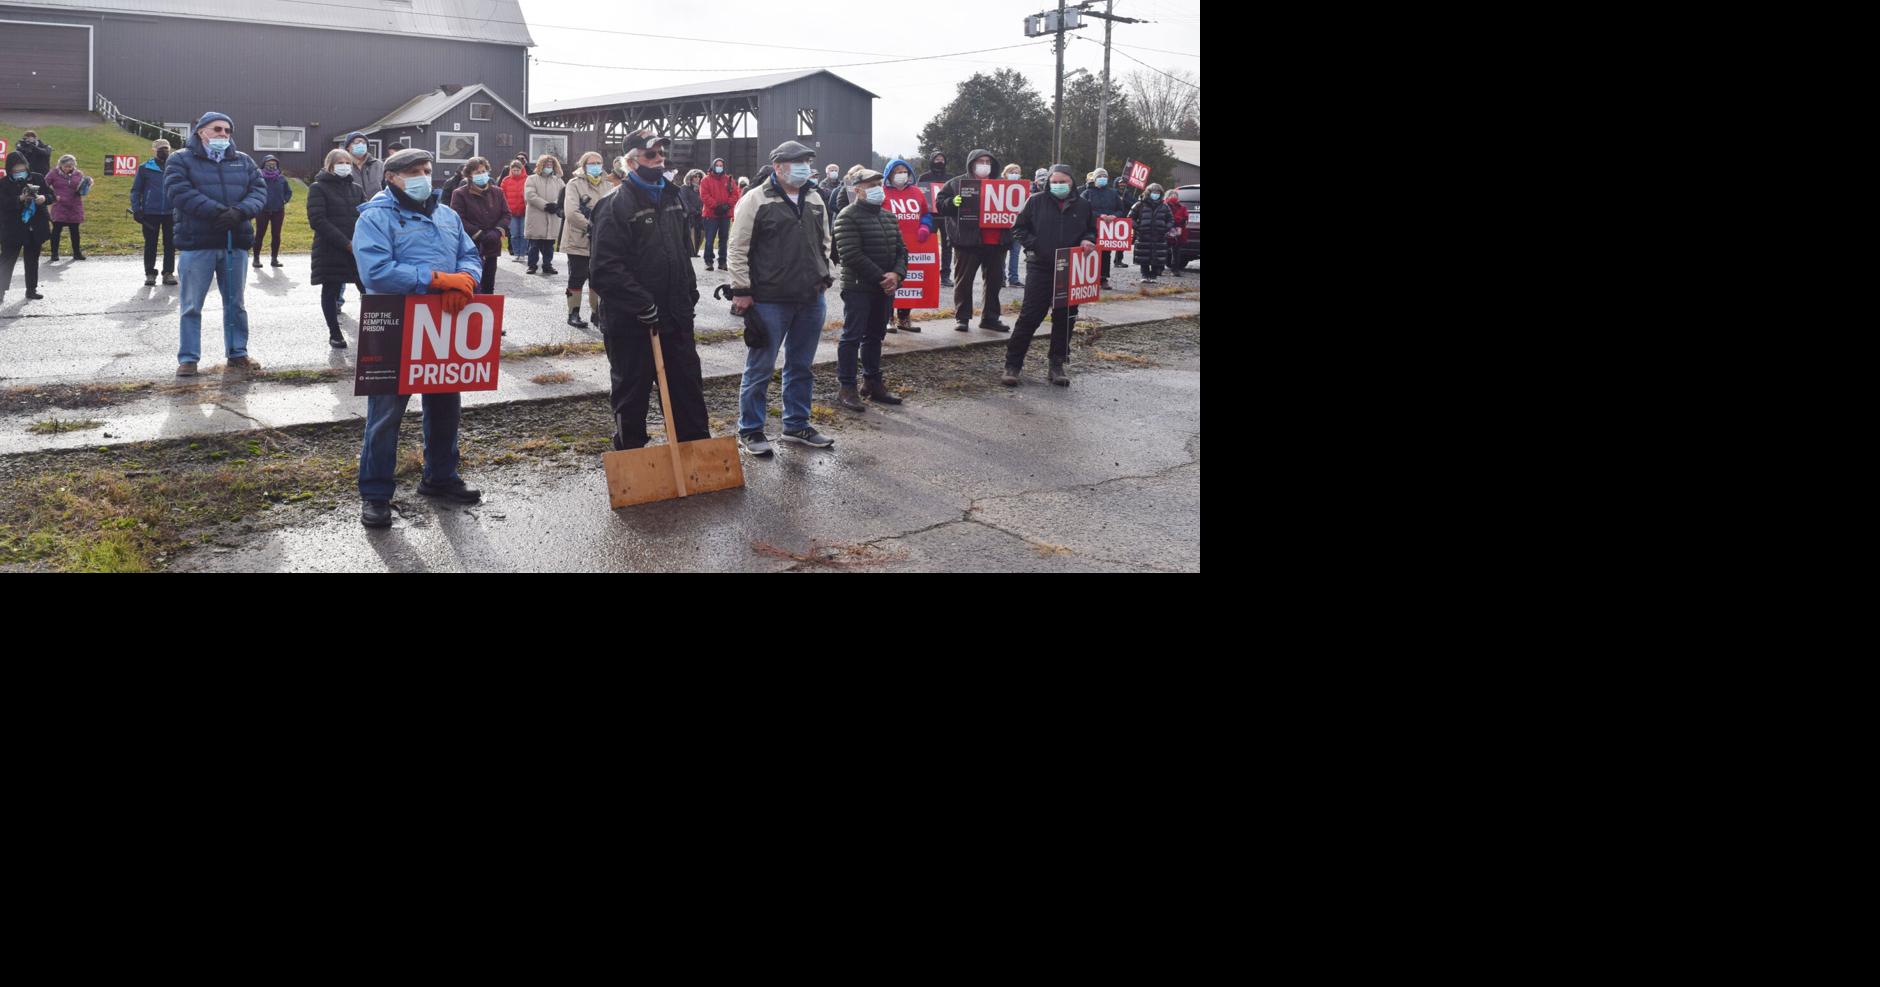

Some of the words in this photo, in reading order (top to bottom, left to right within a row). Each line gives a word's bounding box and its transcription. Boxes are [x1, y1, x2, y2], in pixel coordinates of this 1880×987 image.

[116, 157, 137, 169] NO
[1131, 163, 1148, 181] NO
[984, 183, 1026, 212] NO
[889, 198, 920, 214] NO
[895, 213, 920, 221] RISON
[983, 213, 1019, 224] PRISO
[1099, 220, 1129, 240] NO
[1099, 240, 1129, 248] PRISON
[905, 272, 924, 280] EDS
[1071, 250, 1099, 286] NO
[897, 289, 923, 297] RUTH
[1070, 285, 1098, 301] PRISON
[362, 318, 400, 326] KEMPTVILLE
[410, 302, 495, 361] NO
[408, 361, 492, 386] PRISON
